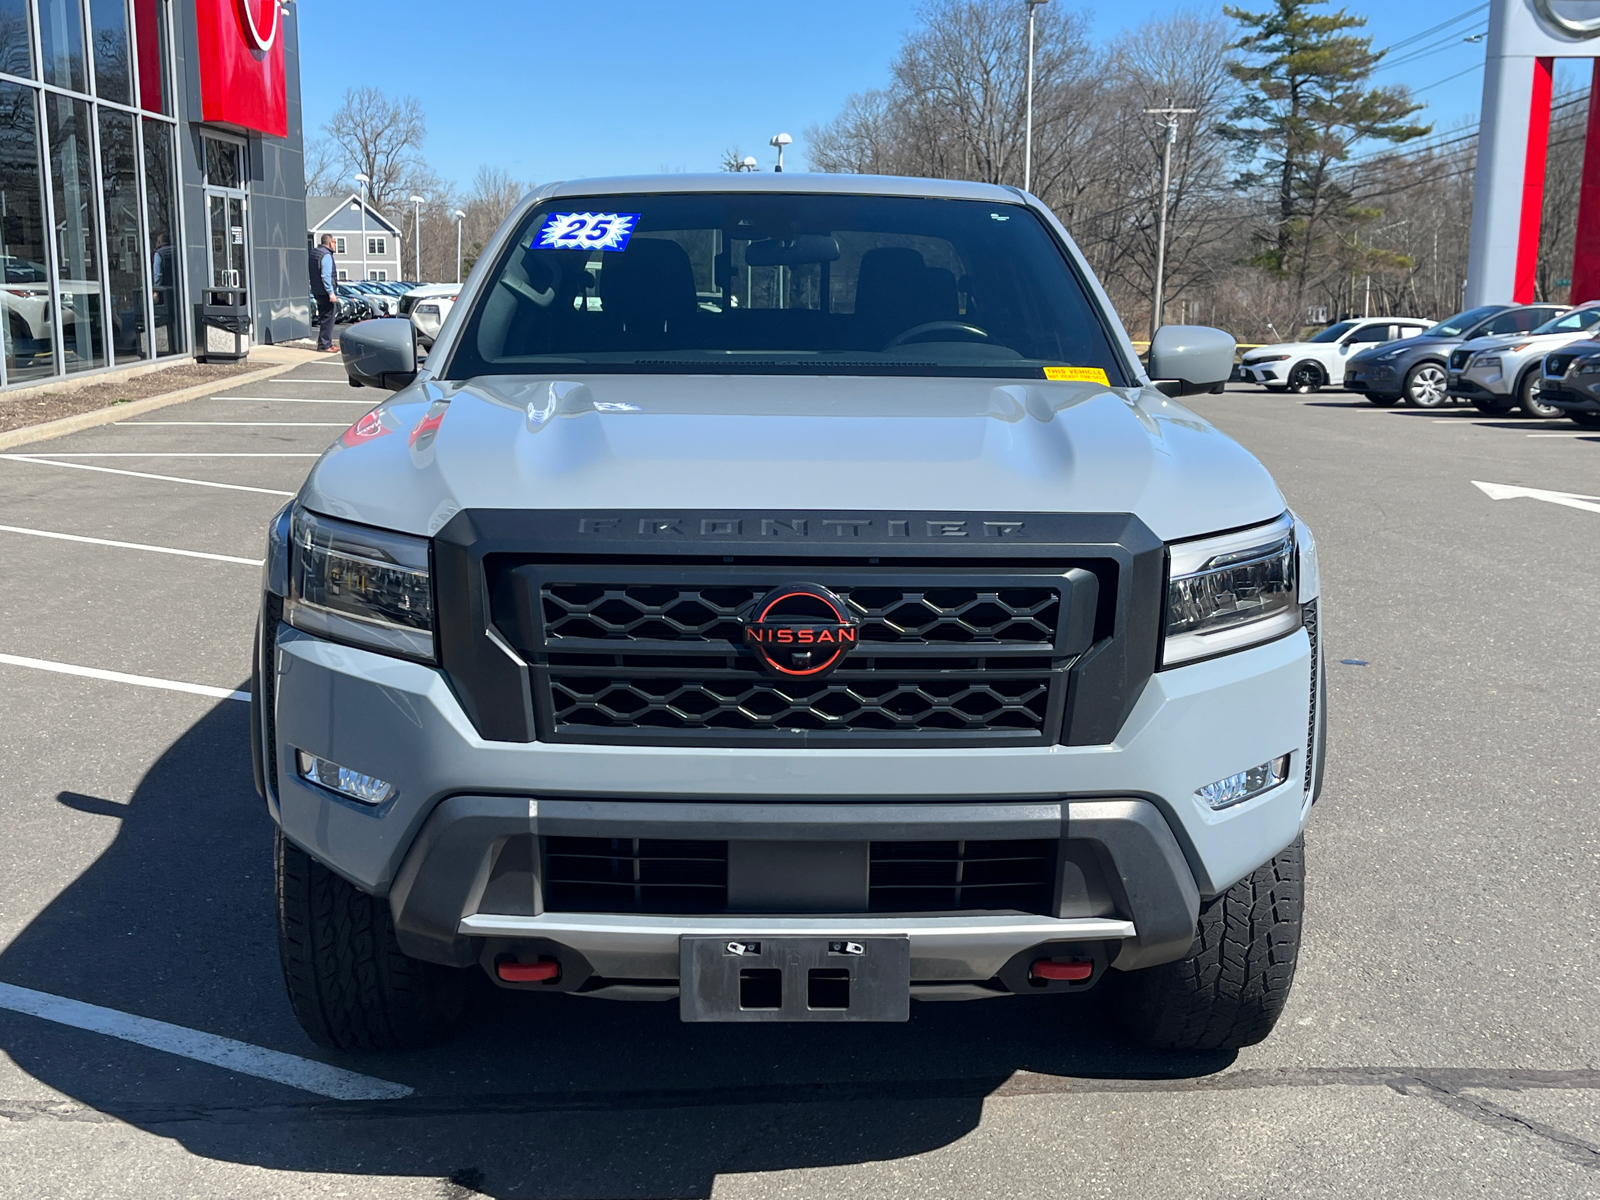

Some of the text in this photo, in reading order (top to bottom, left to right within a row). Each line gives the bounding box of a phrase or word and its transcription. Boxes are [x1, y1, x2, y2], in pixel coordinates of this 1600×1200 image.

[557, 219, 614, 241] 25
[1068, 368, 1103, 376] VEHICLE
[578, 517, 1031, 538] FRONTIER
[747, 627, 855, 643] NISSAN
